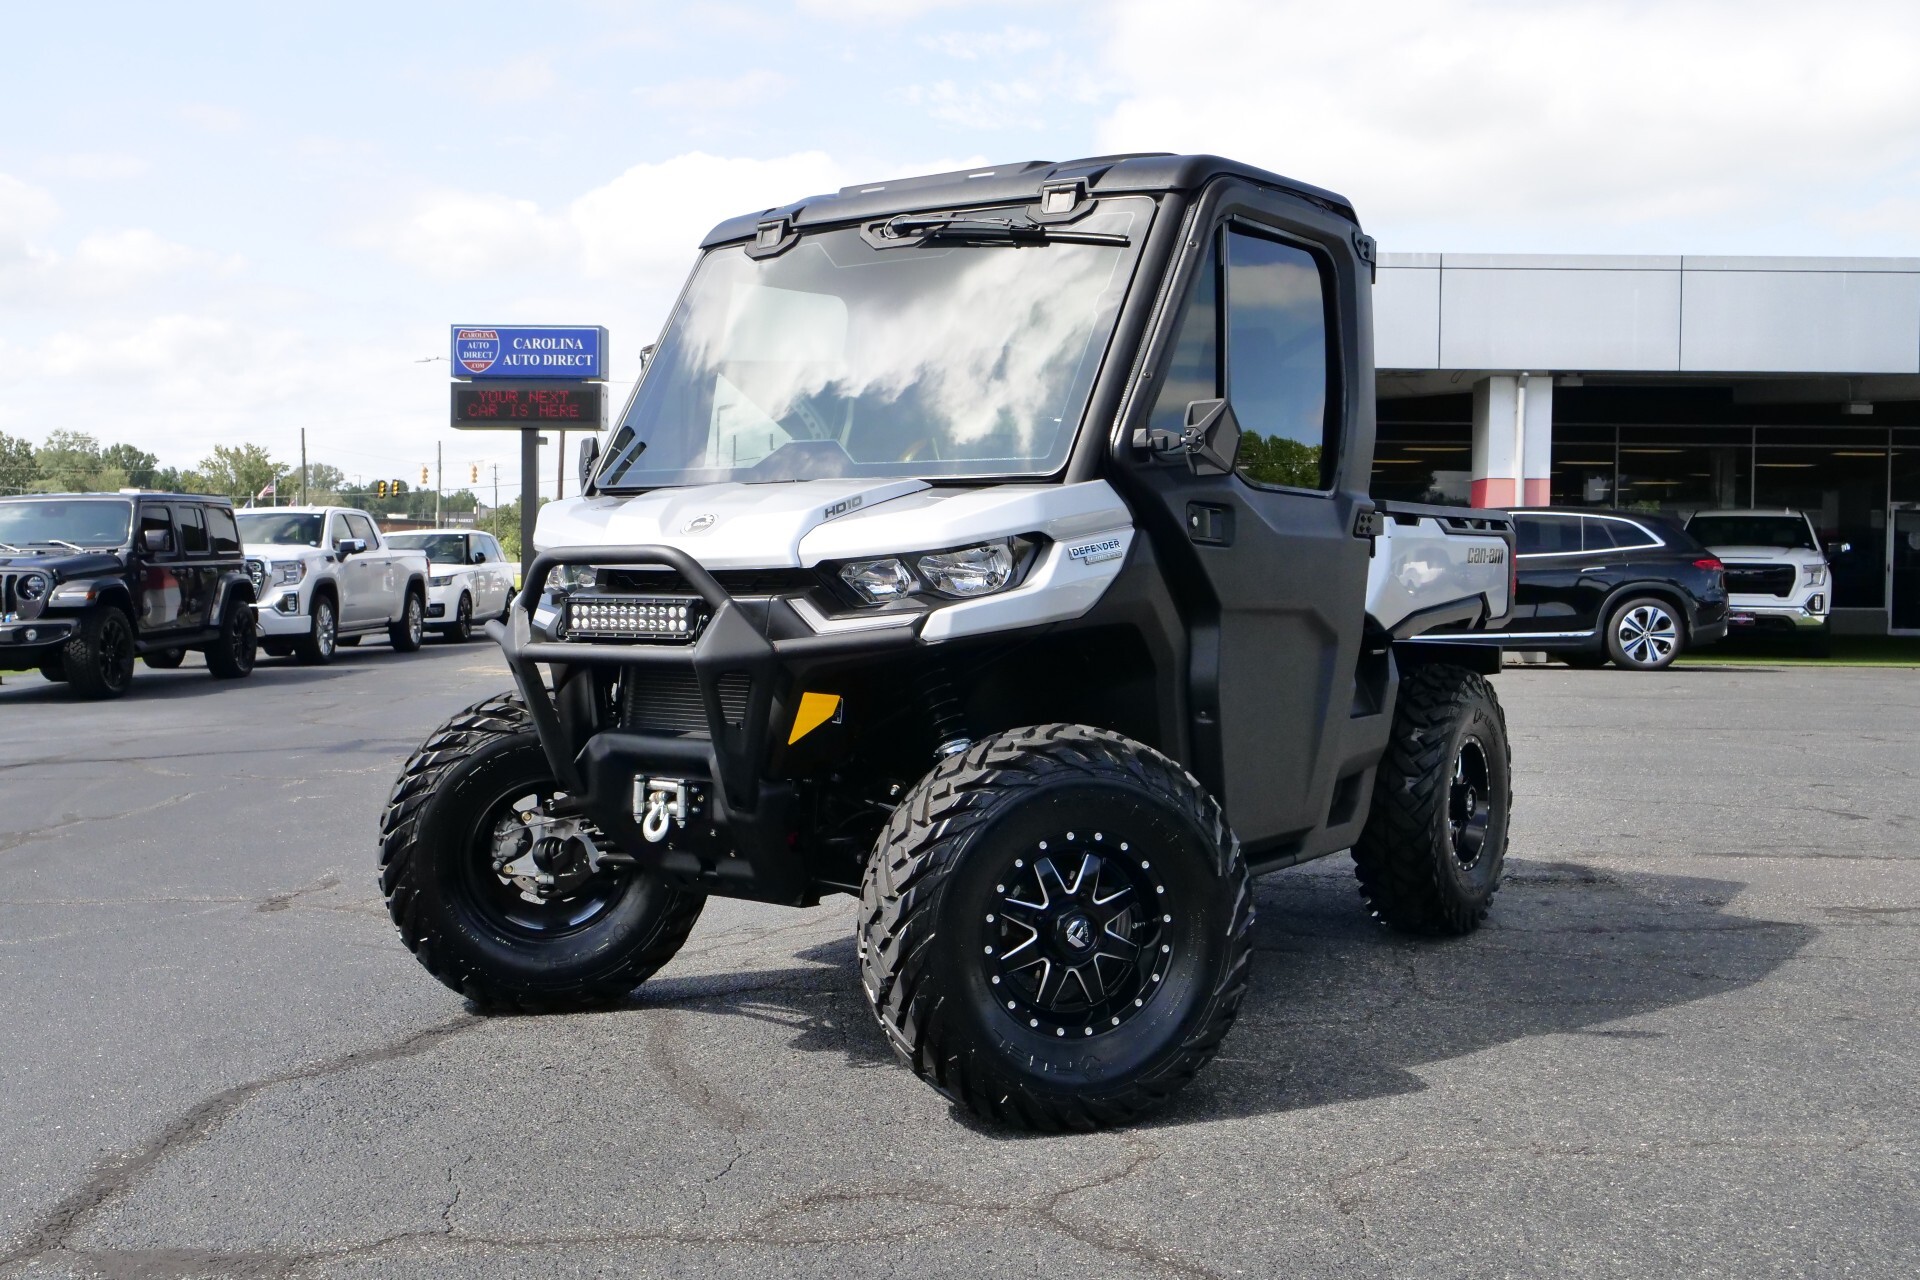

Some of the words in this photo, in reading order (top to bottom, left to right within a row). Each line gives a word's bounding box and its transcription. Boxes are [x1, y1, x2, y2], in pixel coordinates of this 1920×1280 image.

[467, 341, 490, 350] AUTO
[513, 338, 583, 350] CAROLINA
[463, 351, 493, 359] DIRECT
[502, 354, 540, 366] AUTO
[543, 354, 593, 366] DIRECT
[478, 390, 519, 404] YOUR
[529, 390, 570, 404] NEXT
[468, 403, 499, 417] CAR
[511, 403, 529, 417] IS
[539, 403, 580, 417] HERE
[824, 495, 863, 519] HD10
[1072, 540, 1121, 556] DEFENDER
